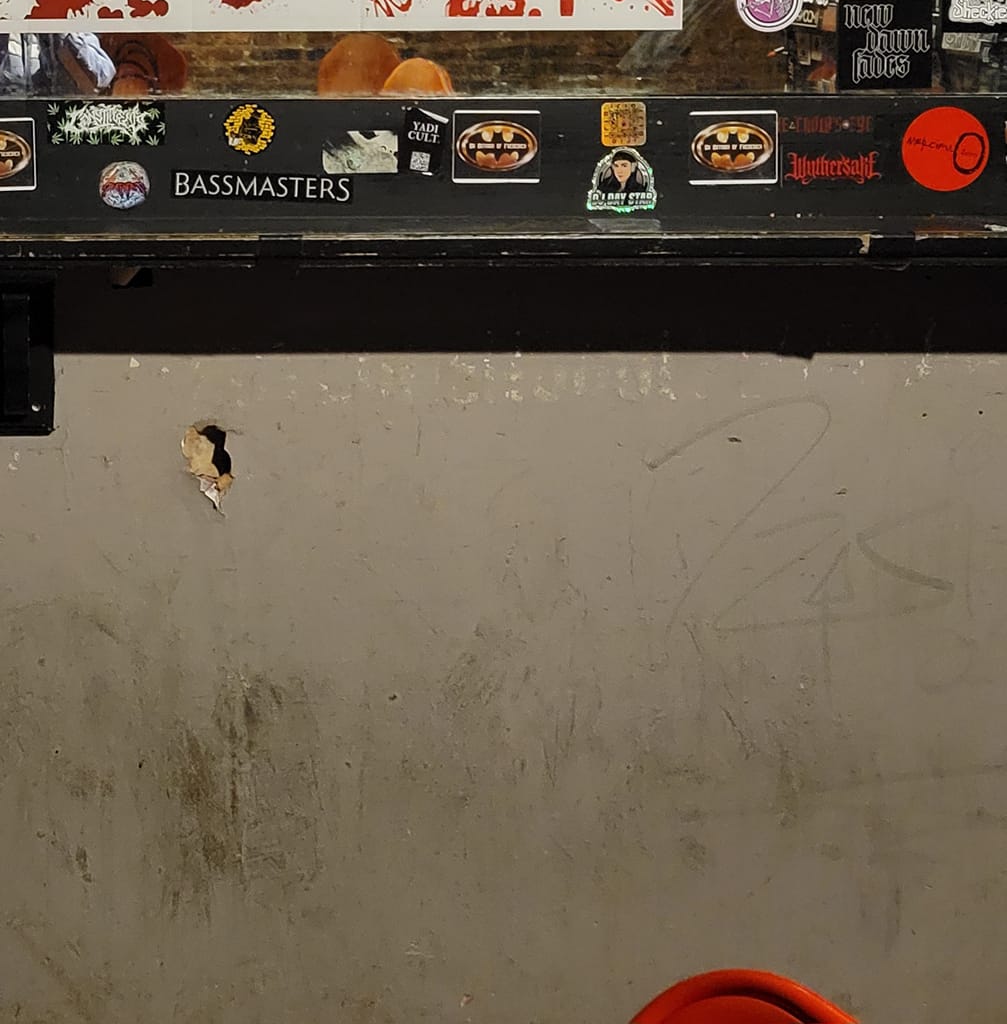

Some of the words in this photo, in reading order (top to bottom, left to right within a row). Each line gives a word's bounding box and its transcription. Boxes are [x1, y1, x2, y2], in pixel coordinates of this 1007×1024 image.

[412, 121, 439, 134] YADI
[174, 172, 351, 202] BASSMASTERS
[607, 191, 627, 206] DAY
[628, 191, 653, 206] STAR
